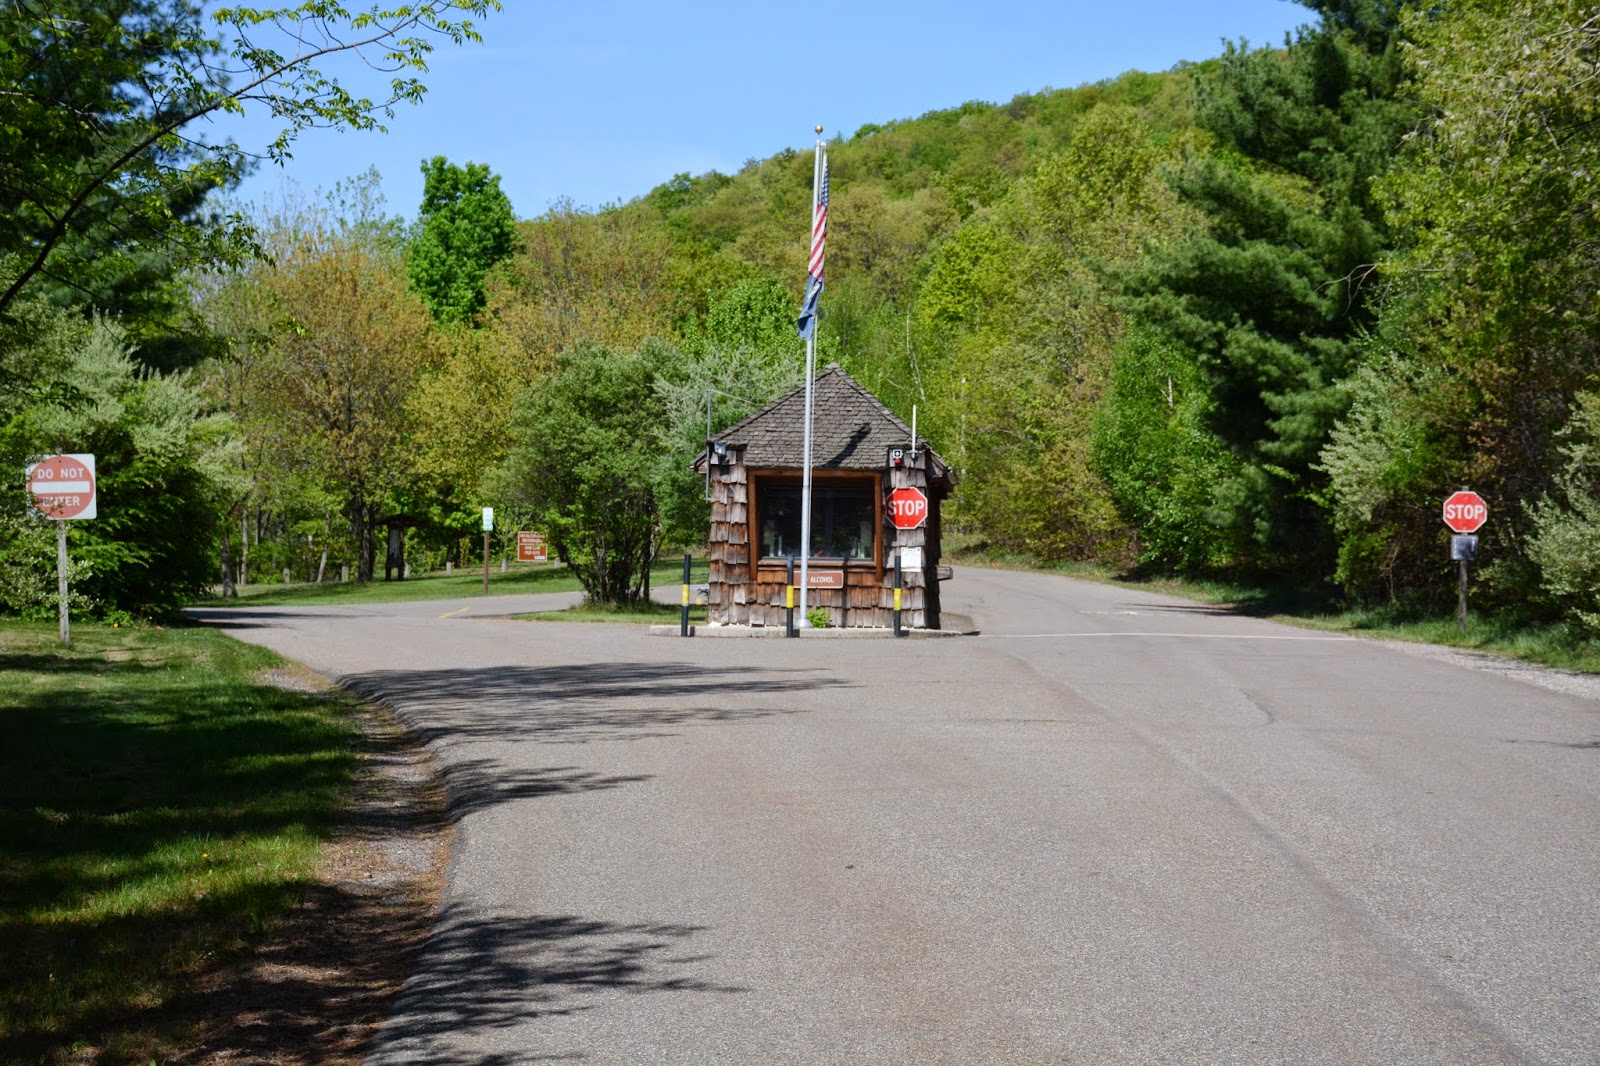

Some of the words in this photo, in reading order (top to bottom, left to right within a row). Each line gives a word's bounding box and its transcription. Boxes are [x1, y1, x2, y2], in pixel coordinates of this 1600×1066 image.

[37, 468, 54, 479] DO
[61, 467, 84, 479] NOT
[888, 500, 925, 516] STOP
[1446, 504, 1484, 520] STOP
